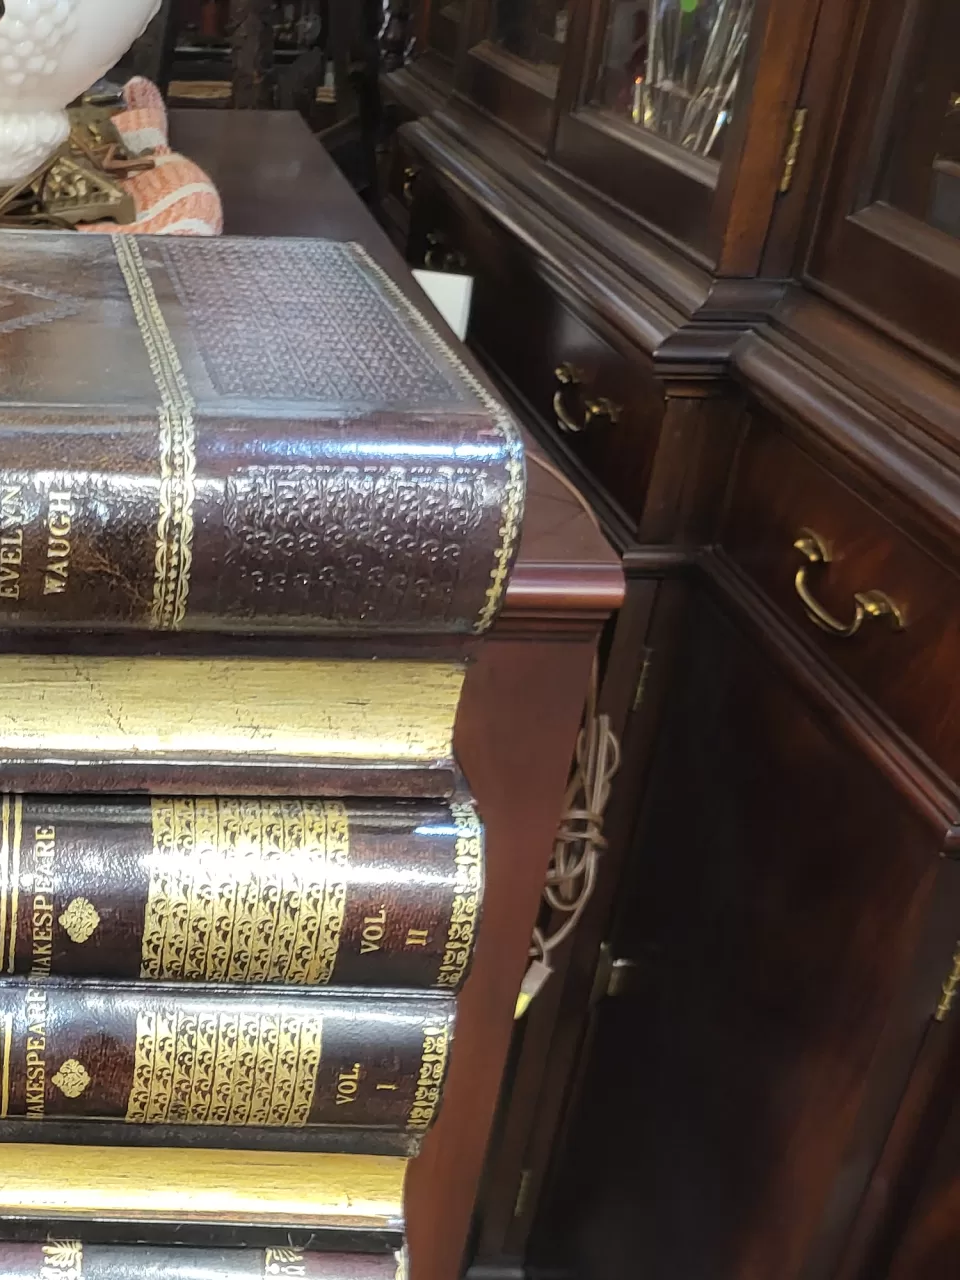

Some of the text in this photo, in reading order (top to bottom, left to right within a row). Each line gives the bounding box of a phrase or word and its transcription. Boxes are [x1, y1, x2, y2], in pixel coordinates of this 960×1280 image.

[43, 490, 74, 596] WAUGH
[360, 903, 387, 955] VOL.
[406, 928, 429, 947] II
[25, 988, 48, 1120] HAKESPEARE
[336, 1062, 361, 1106] VOL.
